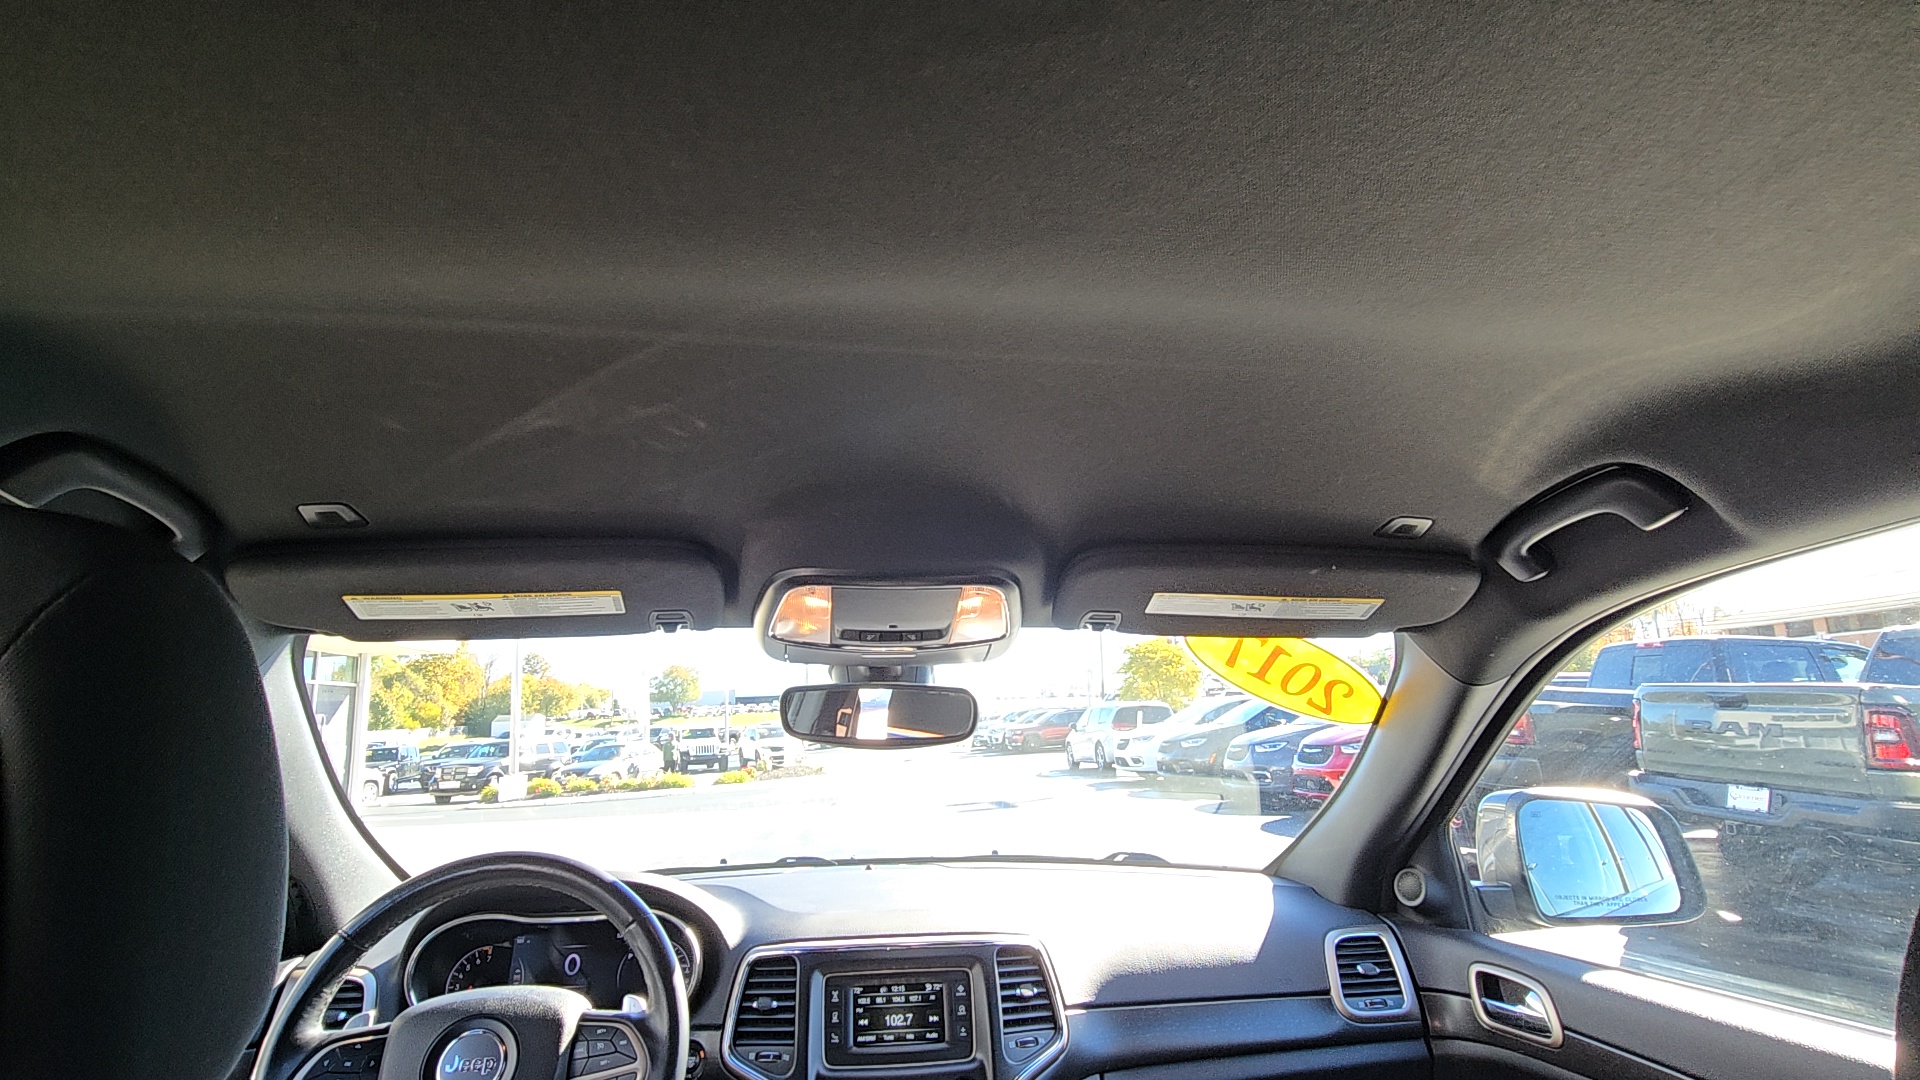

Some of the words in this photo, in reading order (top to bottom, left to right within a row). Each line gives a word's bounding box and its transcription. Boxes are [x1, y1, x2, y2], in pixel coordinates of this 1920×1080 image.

[1685, 719, 1784, 737] RAM
[884, 1013, 913, 1027] 102.7
[444, 1054, 497, 1076] Jeep
